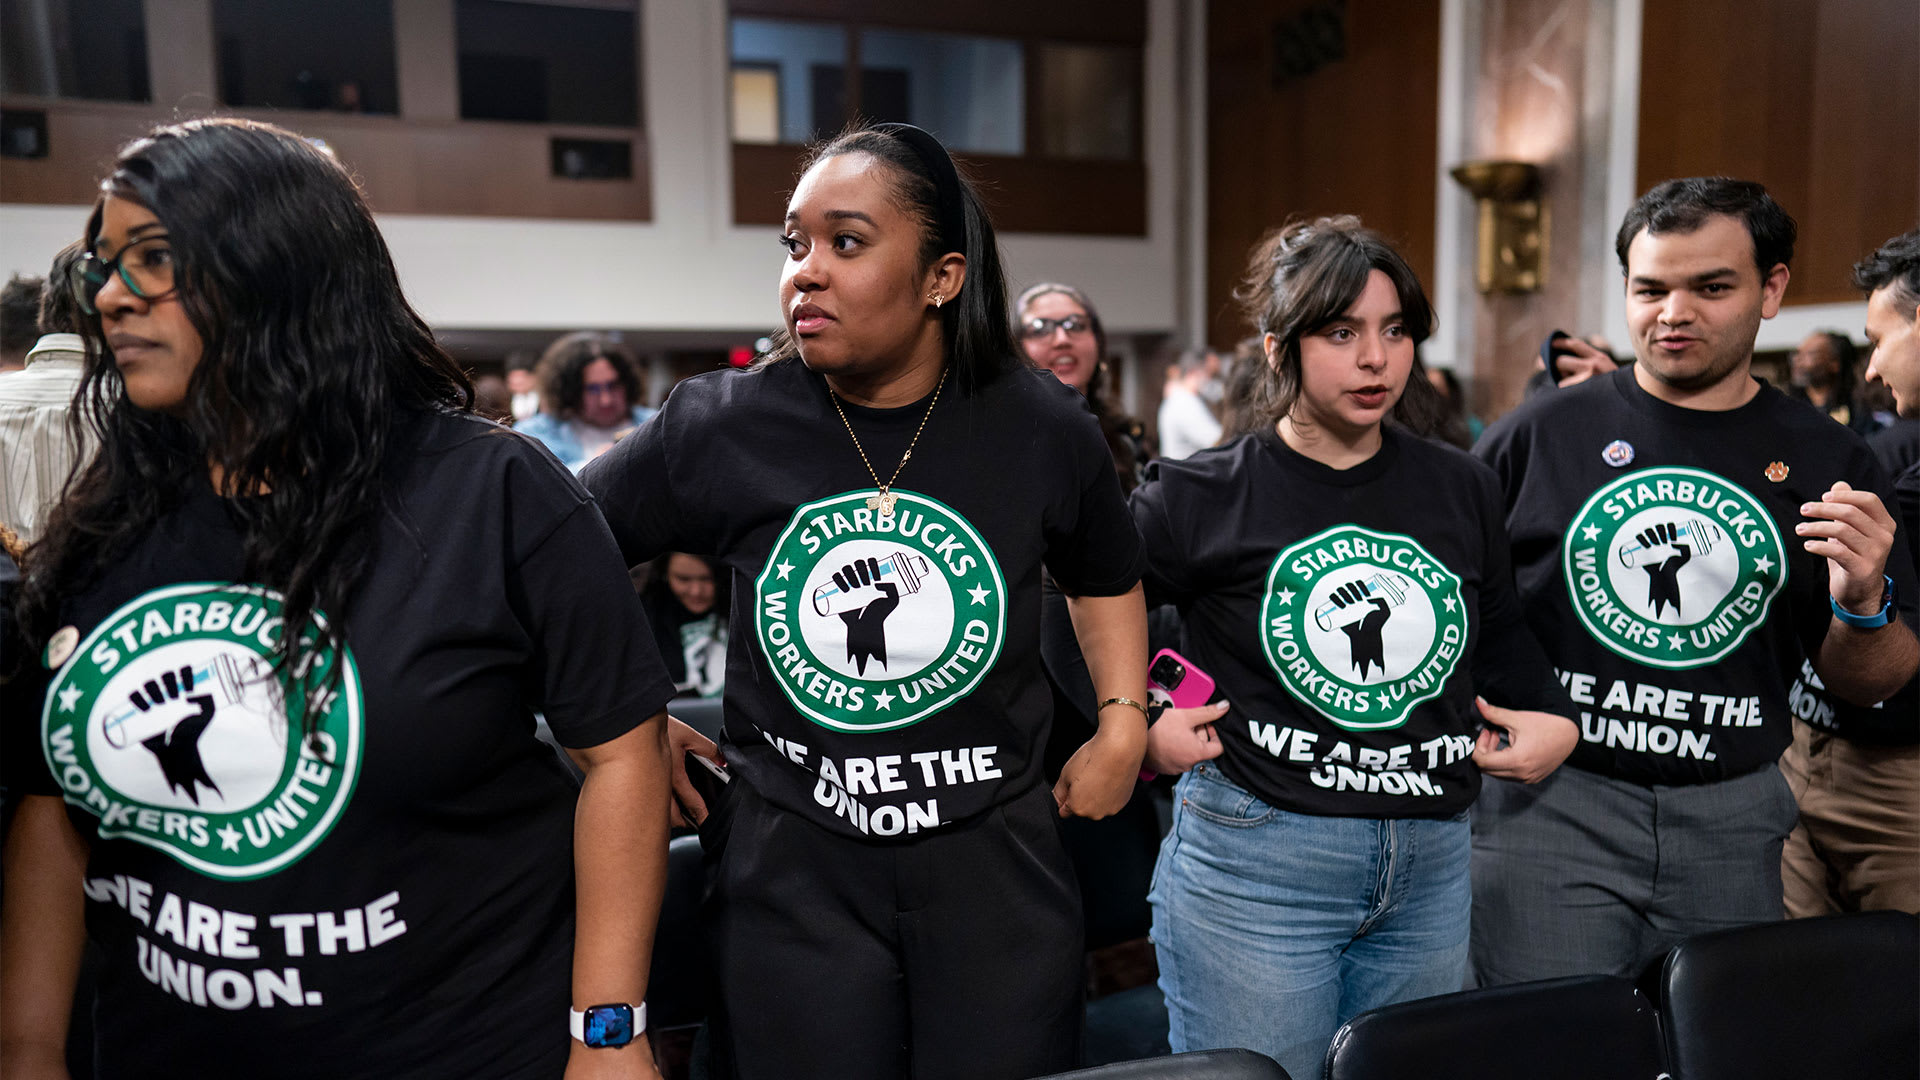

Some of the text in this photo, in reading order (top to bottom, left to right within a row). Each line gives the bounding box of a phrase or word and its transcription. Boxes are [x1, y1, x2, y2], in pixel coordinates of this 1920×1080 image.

[800, 508, 977, 577] STARBUCKS
[1603, 479, 1765, 548] STARBUCKS
[1291, 537, 1446, 590] STARBUCKS
[1575, 547, 1763, 649] WORKERS UNITED
[90, 602, 326, 680] STARBUC
[765, 590, 990, 712] WORKERS UNITED
[1271, 613, 1460, 713] WORKERS UNITED
[1580, 712, 1717, 762] UNION.
[1601, 680, 1693, 721] ARE
[1700, 694, 1763, 727] THE
[820, 755, 908, 795] ARE
[911, 746, 1003, 788] THE
[1248, 720, 1318, 762] WE
[1322, 741, 1412, 772] ARE
[1310, 764, 1443, 796] UNION.
[243, 730, 338, 849] UNITED
[813, 777, 940, 836] UNION
[155, 892, 260, 960] ARE
[269, 891, 408, 957] THE
[137, 936, 323, 1011] UNION.
